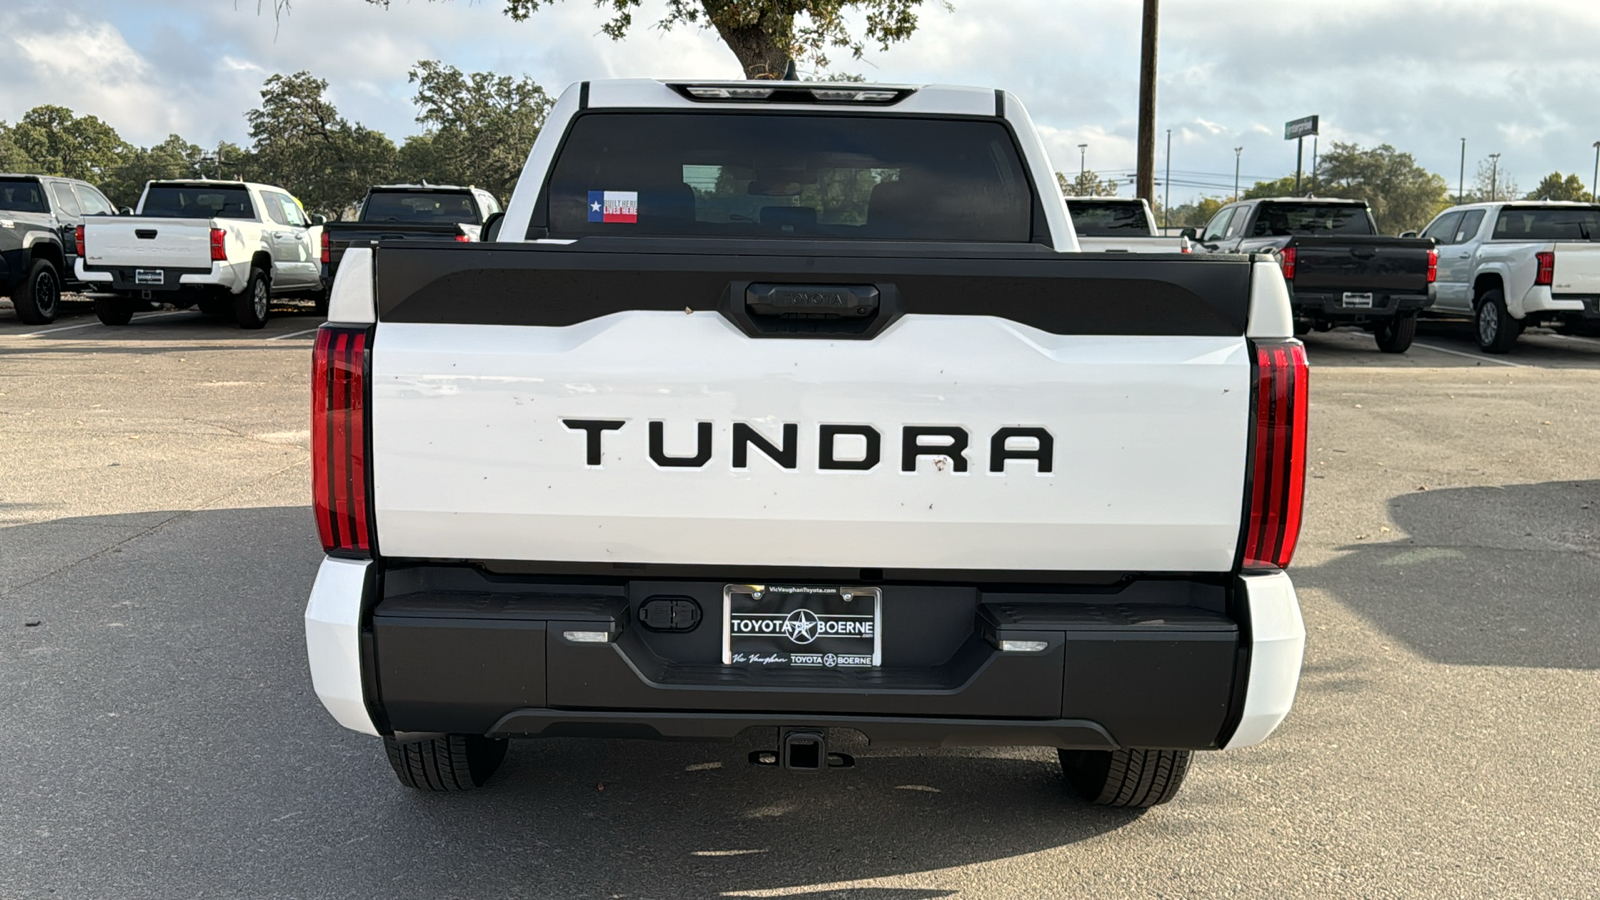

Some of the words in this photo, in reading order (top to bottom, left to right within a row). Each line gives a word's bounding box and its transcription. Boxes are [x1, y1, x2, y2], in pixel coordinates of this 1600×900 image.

[622, 207, 638, 215] HERE
[784, 292, 843, 306] TOYOTA
[561, 418, 1055, 474] TUNDRA
[769, 586, 837, 594] VicVaughanToyota.com
[731, 619, 793, 632] TOYOTA
[817, 621, 874, 633] BOERNE
